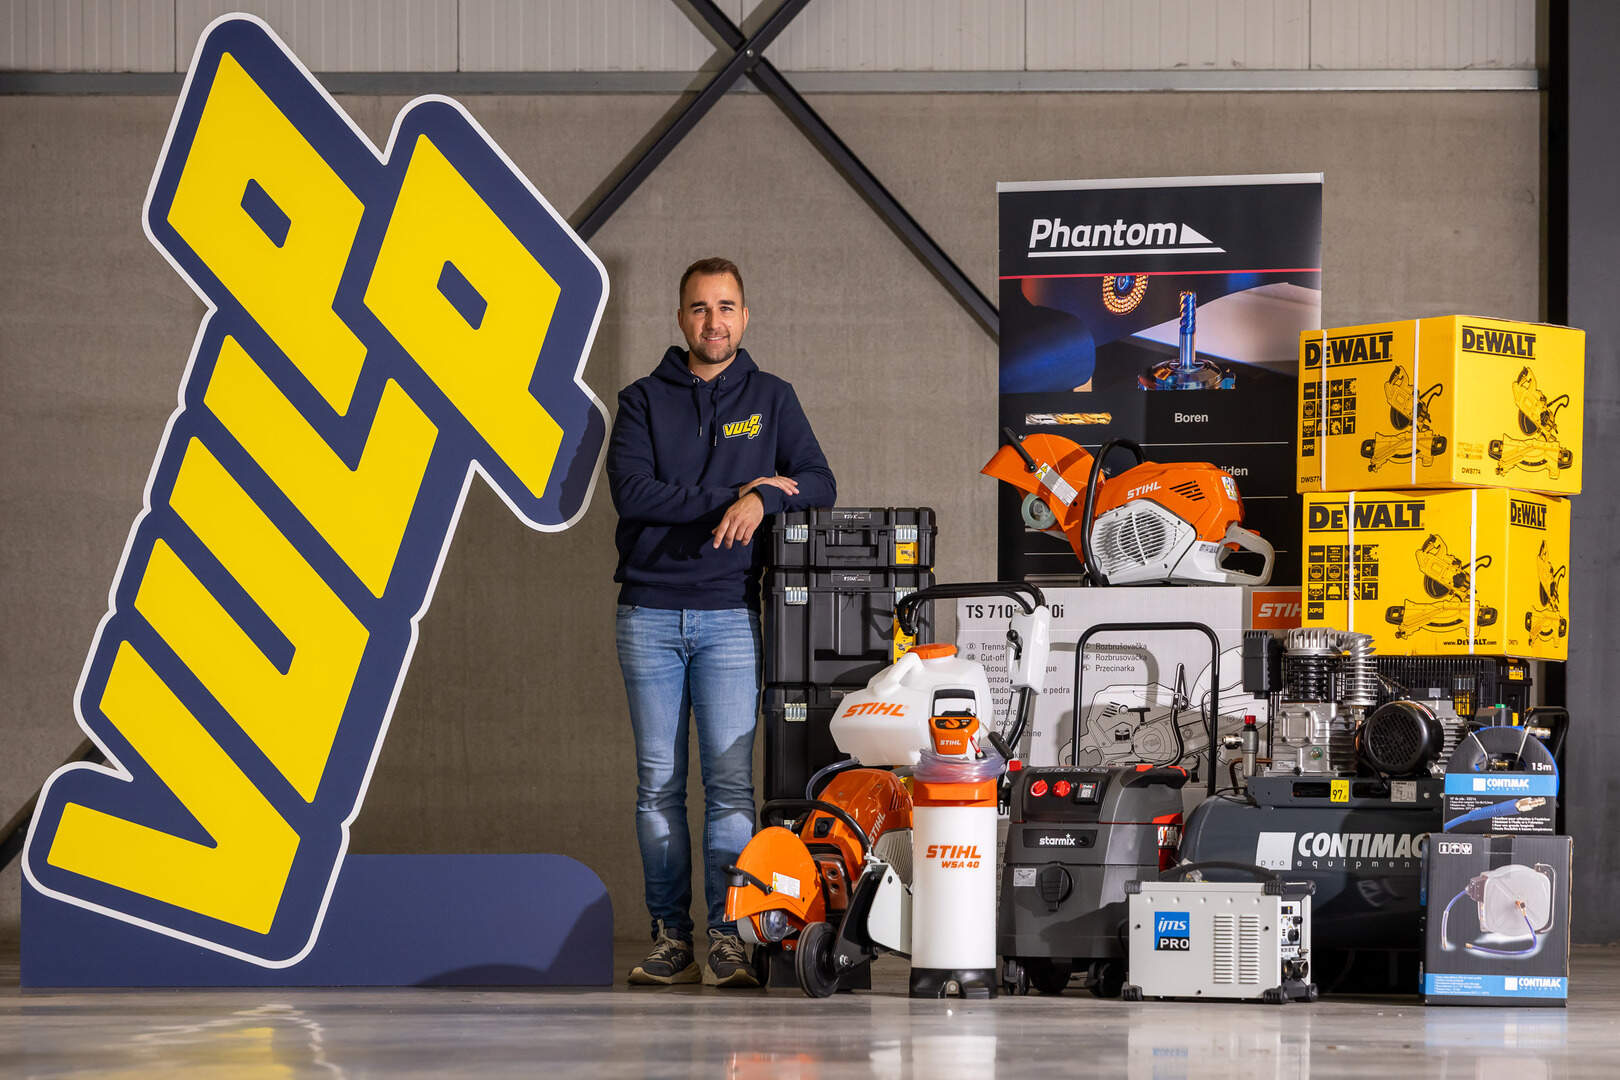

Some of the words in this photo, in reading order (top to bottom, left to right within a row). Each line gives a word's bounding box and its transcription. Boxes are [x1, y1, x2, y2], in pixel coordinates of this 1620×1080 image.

[1029, 218, 1178, 249] Phantom
[1174, 412, 1209, 424] Boren
[1126, 481, 1162, 500] STIHL
[966, 604, 984, 618] TS
[1258, 603, 1302, 617] STIH
[980, 654, 1005, 662] Cut-off
[1095, 664, 1136, 672] Przecinarka
[1049, 686, 1070, 696] pedra
[841, 702, 905, 718] STIHL
[1531, 762, 1552, 771] 15m
[1486, 778, 1530, 788] CONTIMAC
[1332, 789, 1343, 800] 97
[868, 812, 886, 845] STIHL
[1039, 833, 1076, 846] starmix
[1298, 832, 1424, 858] CONTIMAC
[926, 844, 982, 859] STIHL
[941, 861, 965, 869] WSA
[966, 861, 980, 869] 40
[1159, 938, 1190, 950] PRO
[1518, 977, 1561, 988] CONTIMAC
